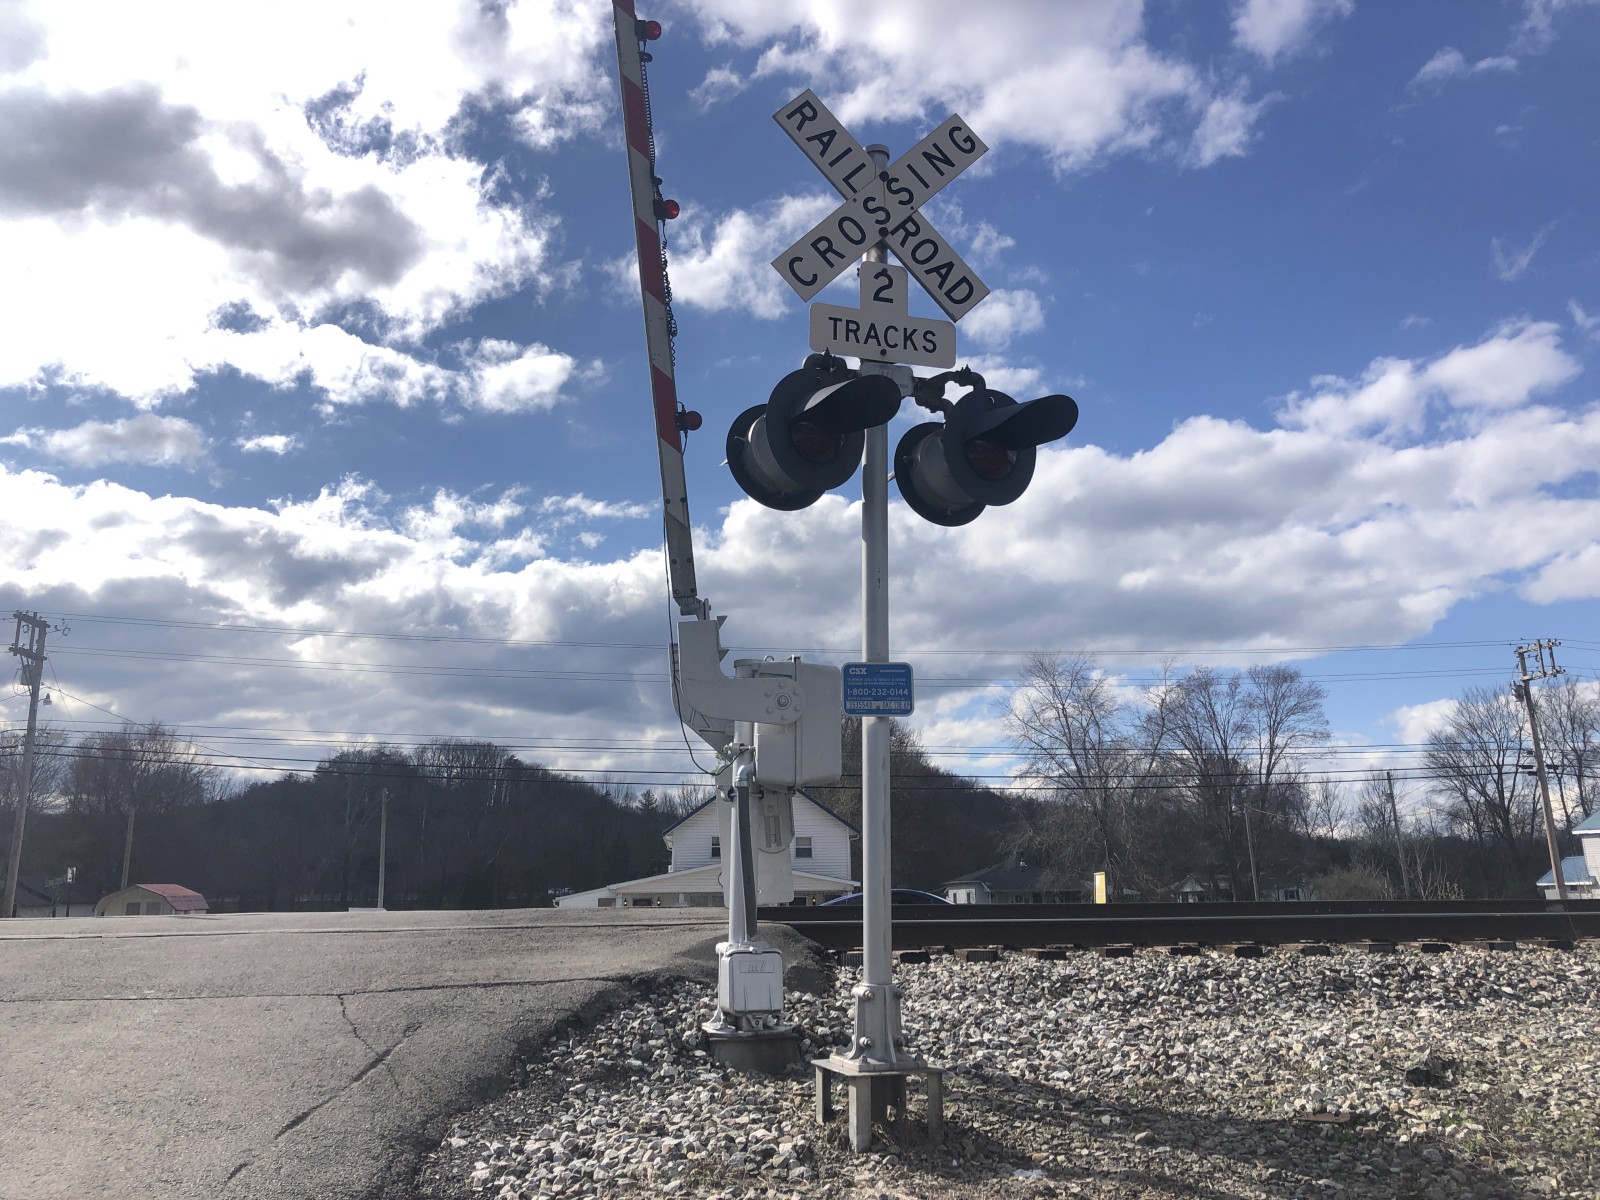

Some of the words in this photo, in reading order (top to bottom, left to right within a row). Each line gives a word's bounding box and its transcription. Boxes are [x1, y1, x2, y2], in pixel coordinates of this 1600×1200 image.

[785, 99, 865, 194] RAIL
[788, 125, 976, 287] CROSSING
[872, 267, 894, 304] 2
[889, 215, 974, 305] ROAD
[828, 316, 937, 354] TRACKS
[849, 667, 868, 675] CSX
